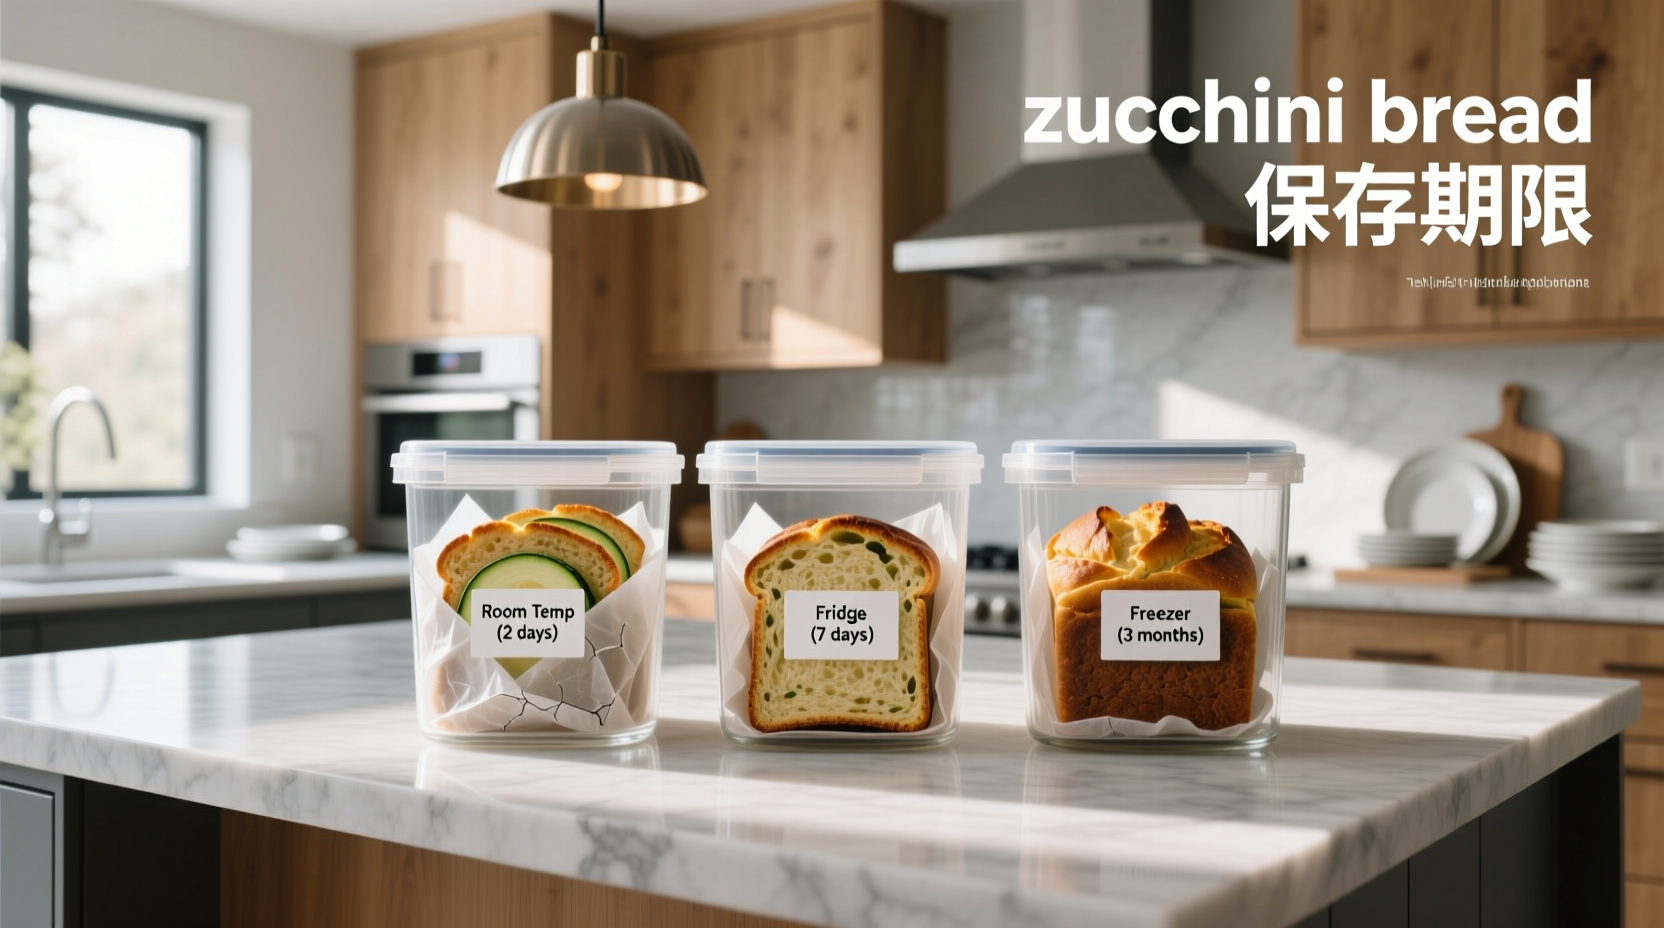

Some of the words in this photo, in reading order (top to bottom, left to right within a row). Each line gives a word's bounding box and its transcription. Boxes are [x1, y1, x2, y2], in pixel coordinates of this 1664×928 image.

[481, 603, 527, 621] Room
[531, 603, 575, 623] Temp
[815, 604, 867, 625] Fridge
[1129, 605, 1191, 621] Freezer
[496, 623, 513, 643] (2
[516, 623, 559, 643] days)
[810, 625, 826, 645] (7
[830, 625, 874, 645] days)
[1117, 625, 1134, 646] (3
[1137, 626, 1204, 646] months)
